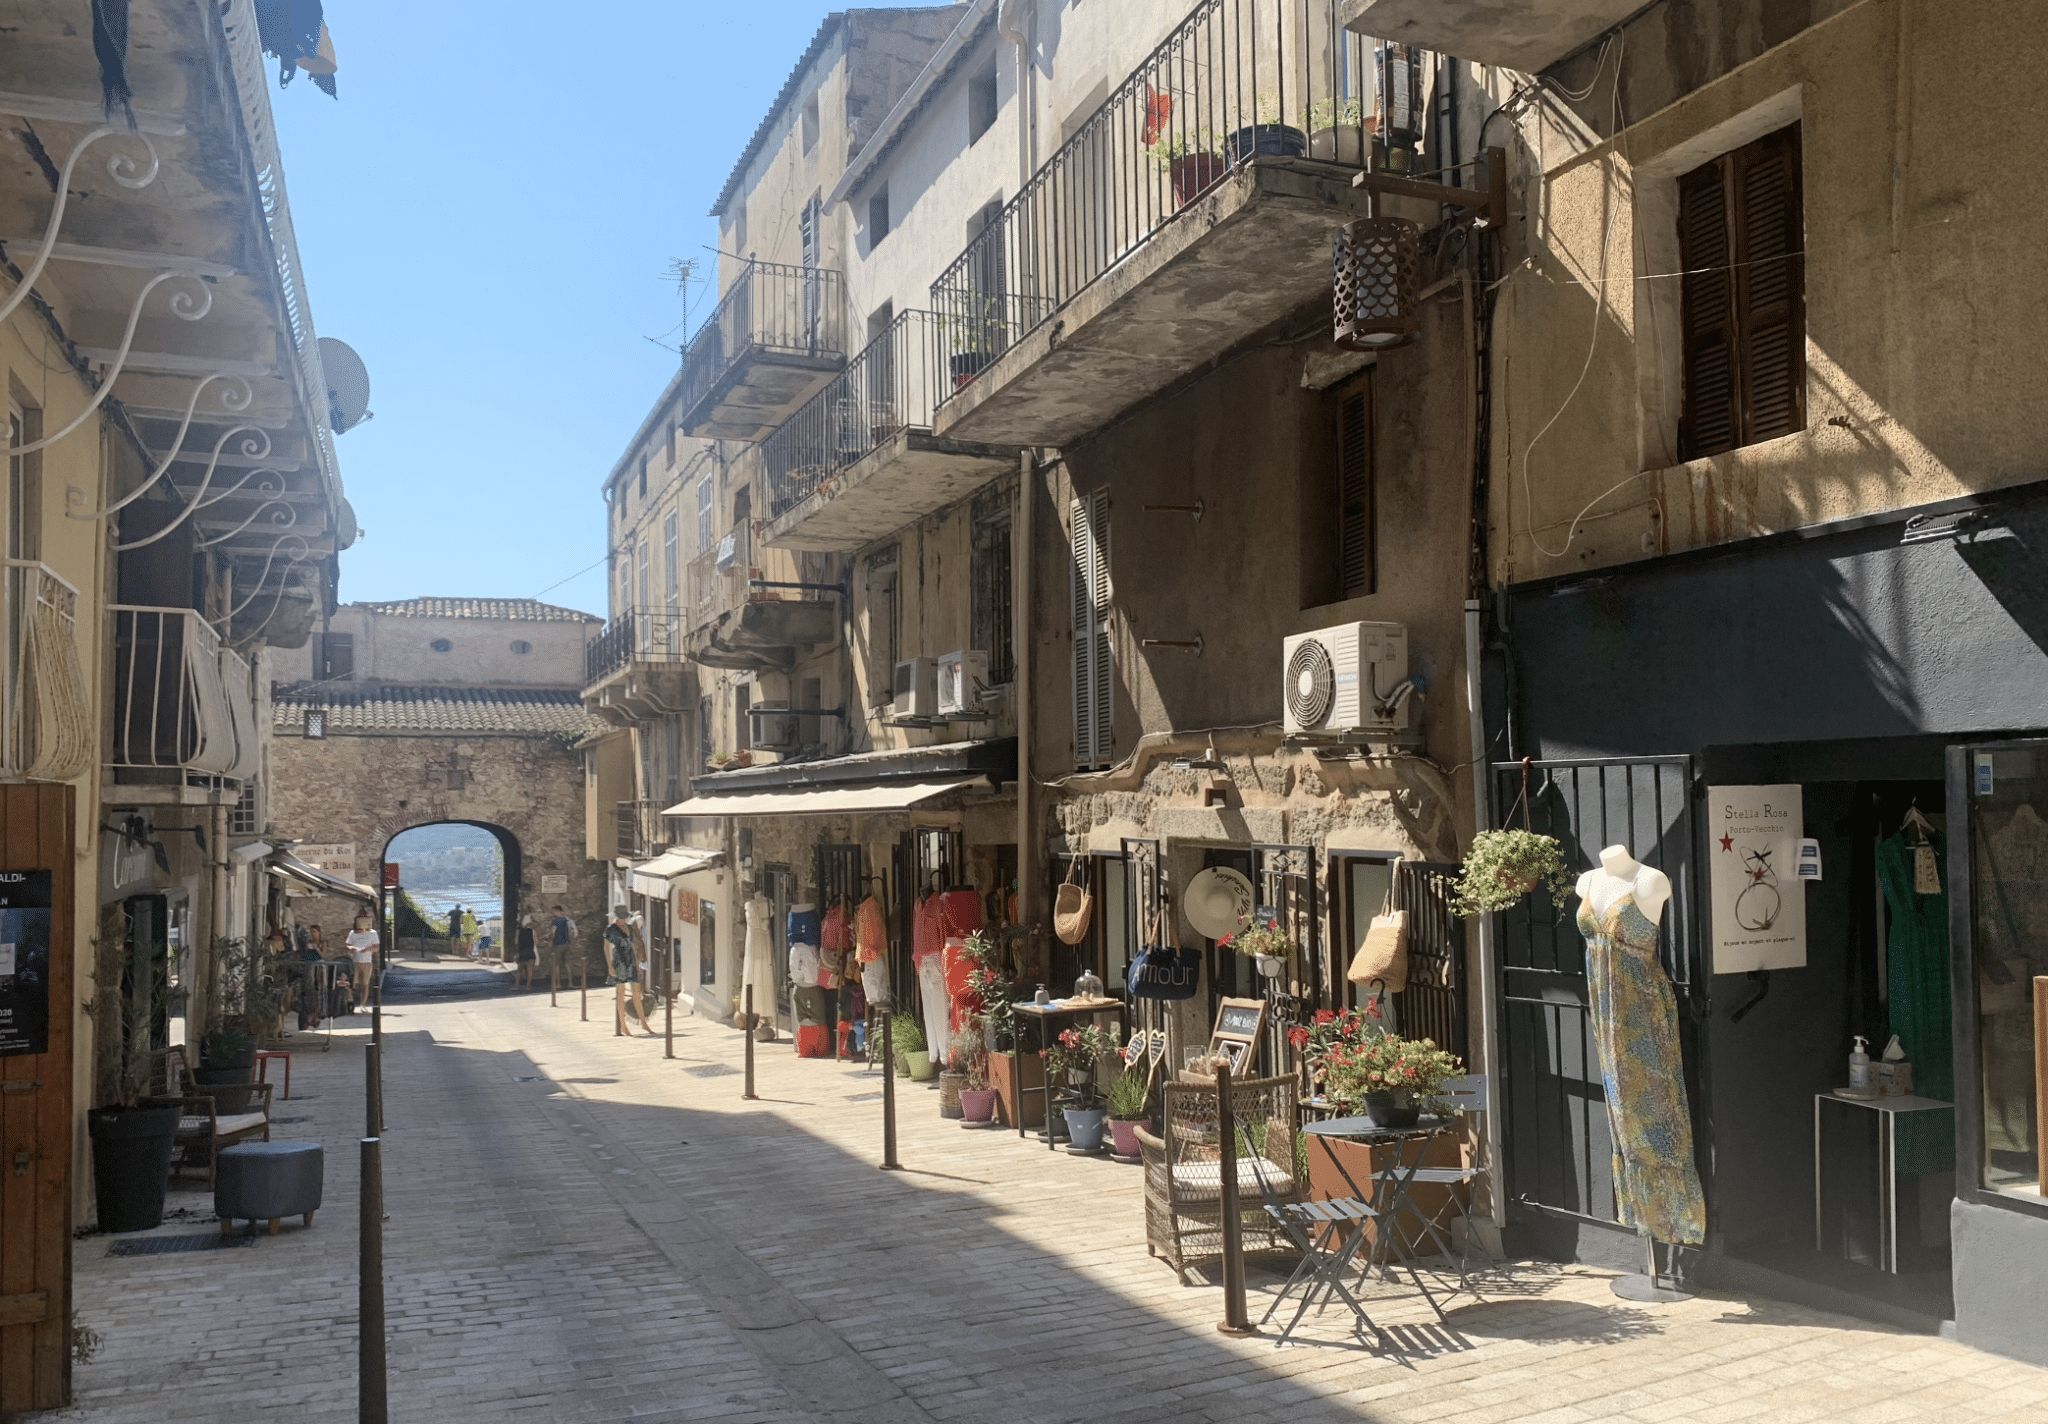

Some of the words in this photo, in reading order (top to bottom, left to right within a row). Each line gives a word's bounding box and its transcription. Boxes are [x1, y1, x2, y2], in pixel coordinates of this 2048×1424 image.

[1725, 805, 1759, 819] Stella
[1763, 804, 1788, 818] Rosa
[1729, 825, 1784, 834] Porto-Vecchio
